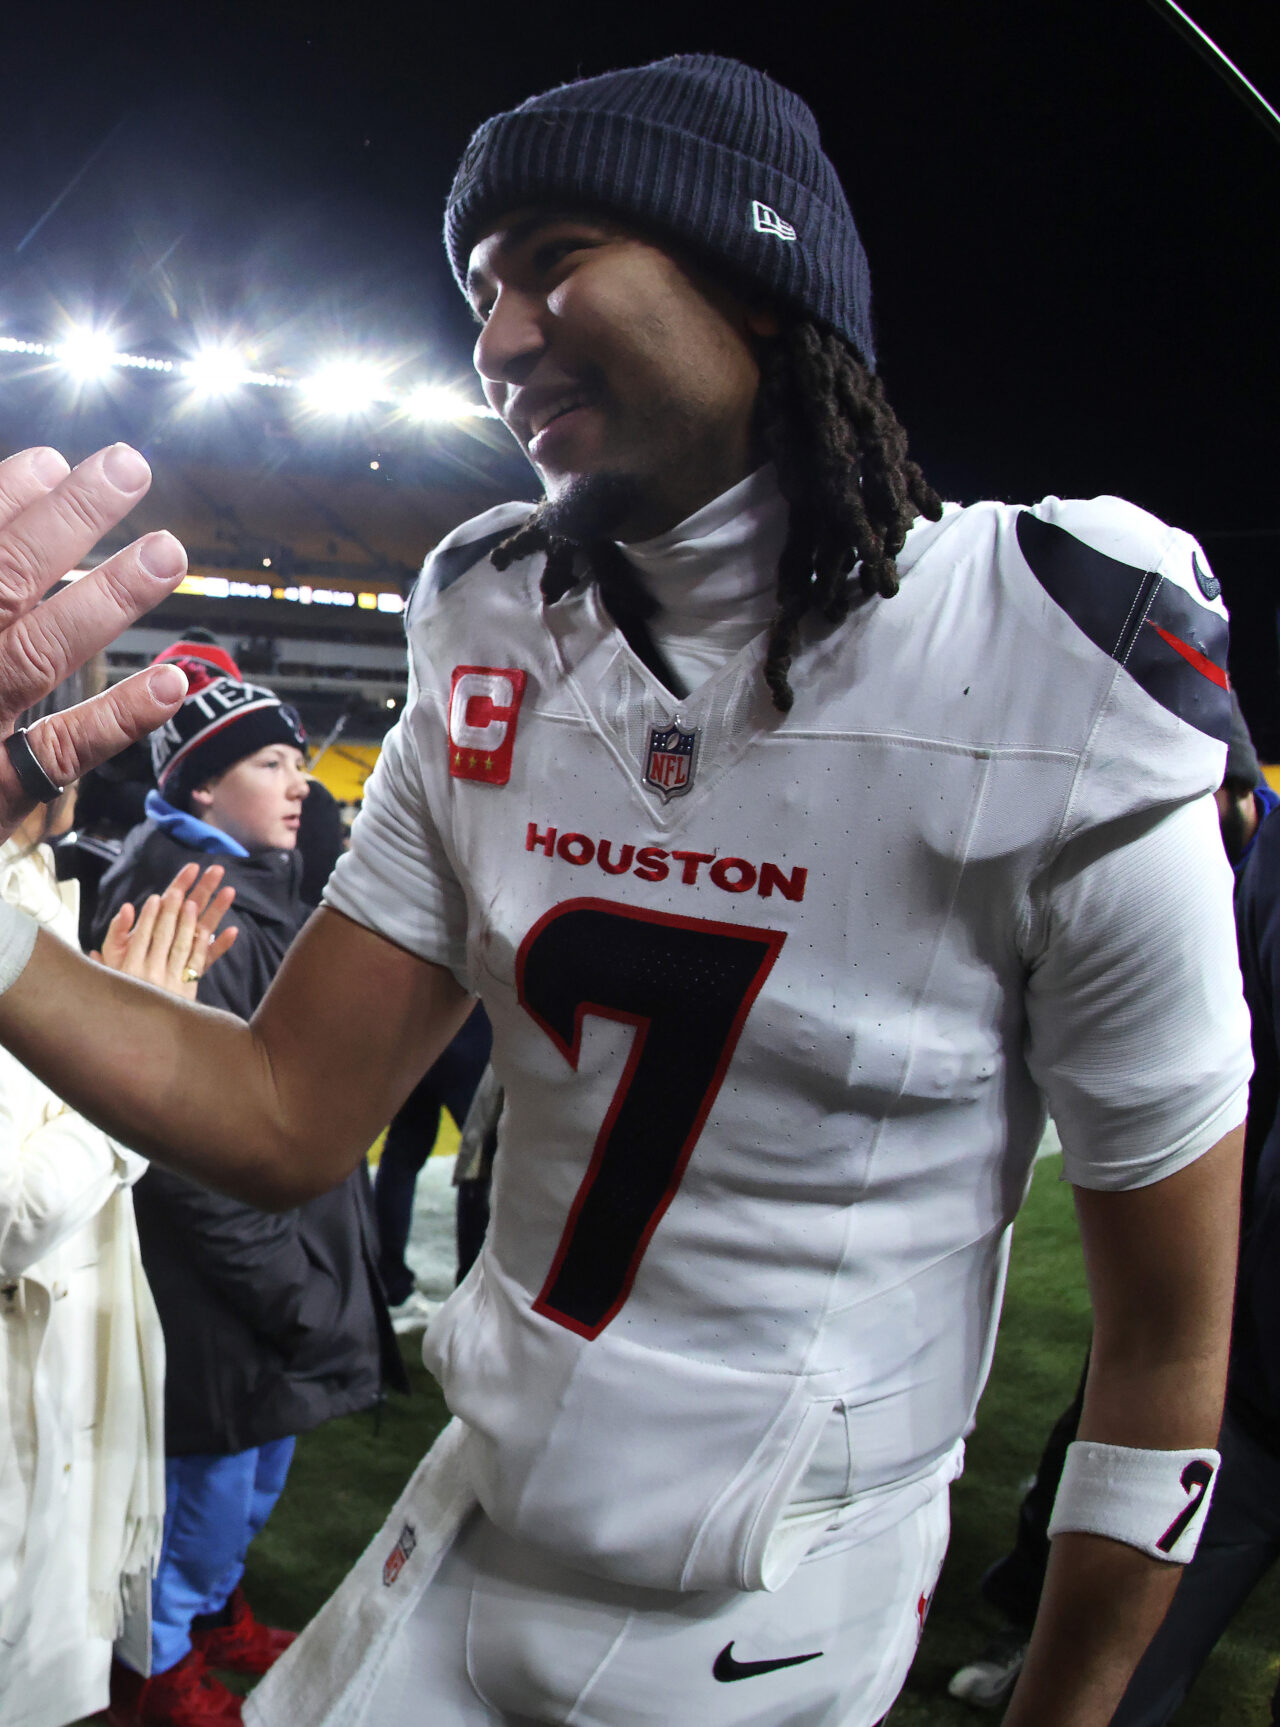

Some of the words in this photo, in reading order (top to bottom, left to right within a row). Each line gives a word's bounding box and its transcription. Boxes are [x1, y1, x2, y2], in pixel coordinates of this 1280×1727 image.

[450, 673, 514, 752] C
[649, 752, 687, 787] NFL
[525, 822, 808, 902] HOUSTON
[516, 896, 787, 1341] 7
[1155, 1460, 1214, 1553] 7
